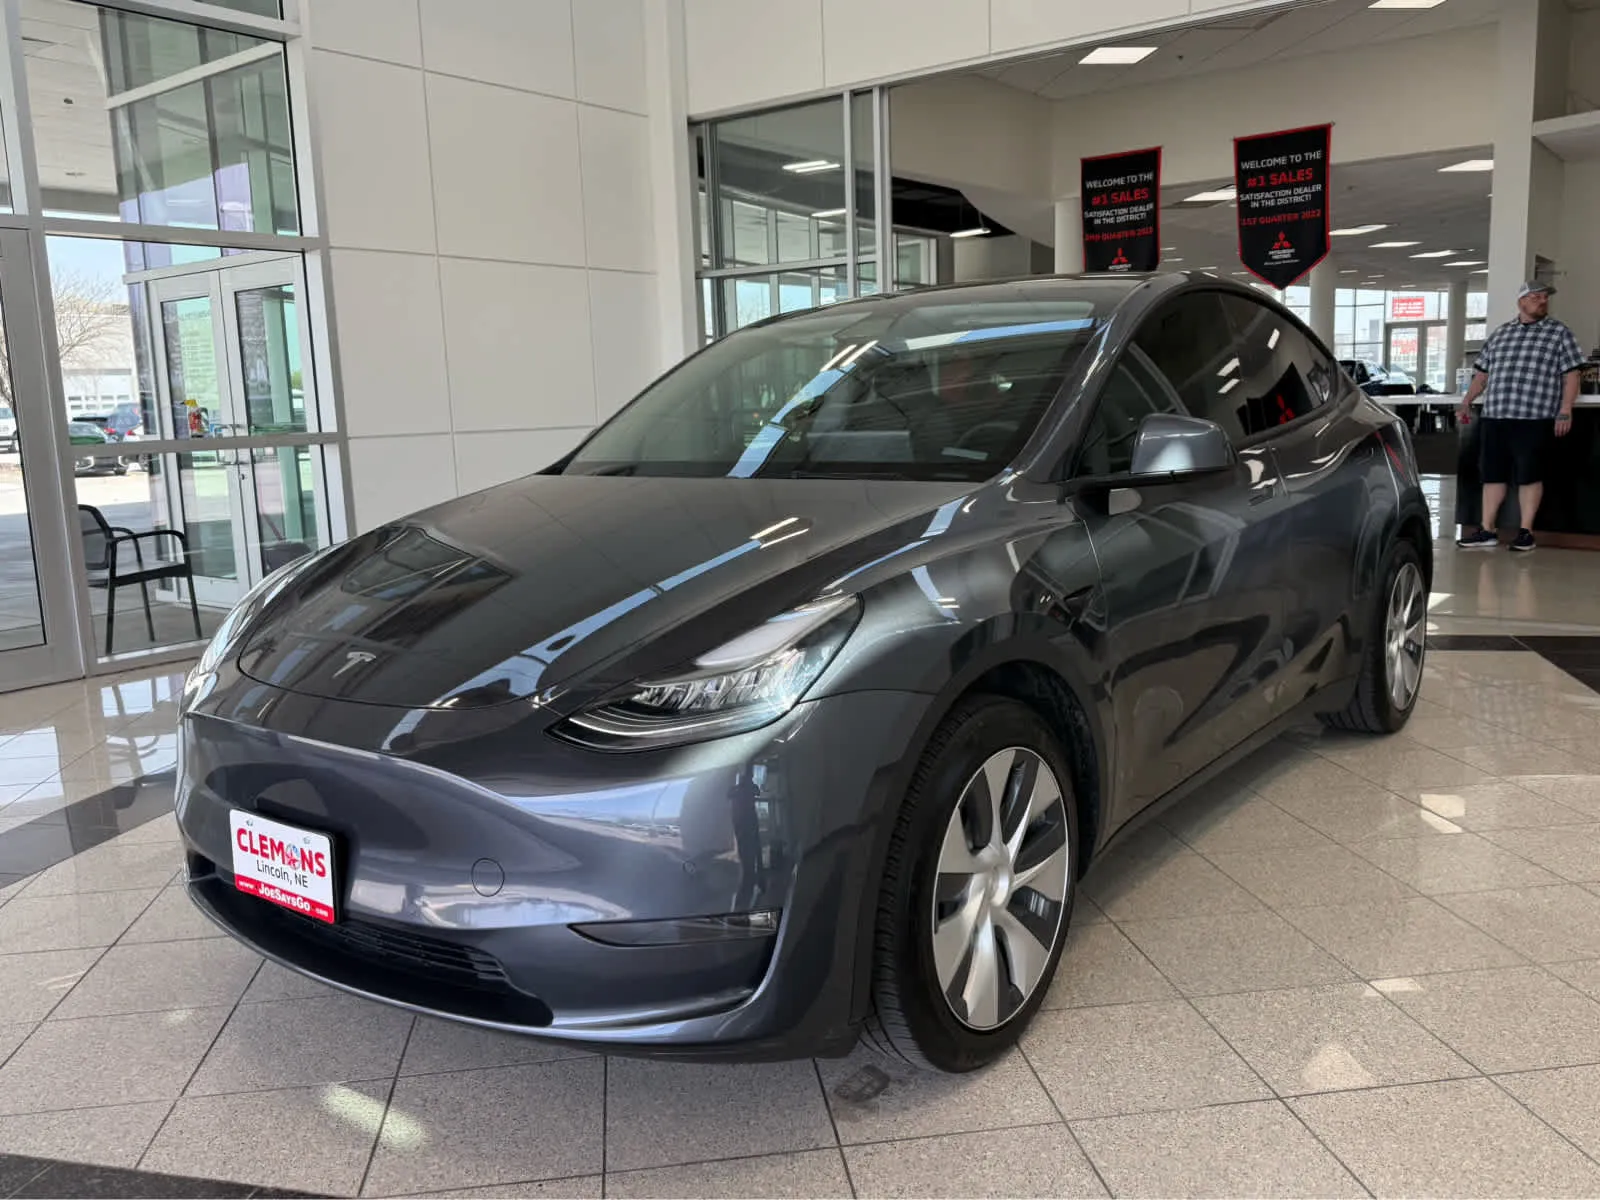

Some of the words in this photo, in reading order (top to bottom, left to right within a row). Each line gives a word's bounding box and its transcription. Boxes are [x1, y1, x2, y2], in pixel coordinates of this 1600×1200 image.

[1241, 156, 1288, 169] WELCOME
[1289, 154, 1302, 163] TO
[1304, 150, 1322, 160] THE
[1085, 176, 1126, 189] WELCOME
[1126, 175, 1138, 184] TO
[1138, 171, 1154, 182] THE
[1247, 175, 1266, 188] #1
[1269, 168, 1313, 186] SALES
[1091, 193, 1108, 206] #1
[1111, 187, 1149, 204] SALES
[1240, 189, 1291, 201] SATISFACTION
[1293, 183, 1322, 195] DEALER
[1261, 198, 1275, 207] THE
[1276, 194, 1312, 206] DISTRICT!
[1084, 208, 1128, 219] SATISFACTION
[1129, 202, 1154, 213] DEALER
[1116, 212, 1147, 223] DISTRICT!
[1241, 217, 1257, 226] 1ST
[1258, 212, 1299, 225] QUARTER
[1101, 230, 1136, 241] QUARTER
[237, 828, 326, 877] CLEMONS
[257, 859, 293, 885] Lincoln,
[295, 872, 308, 888] NE
